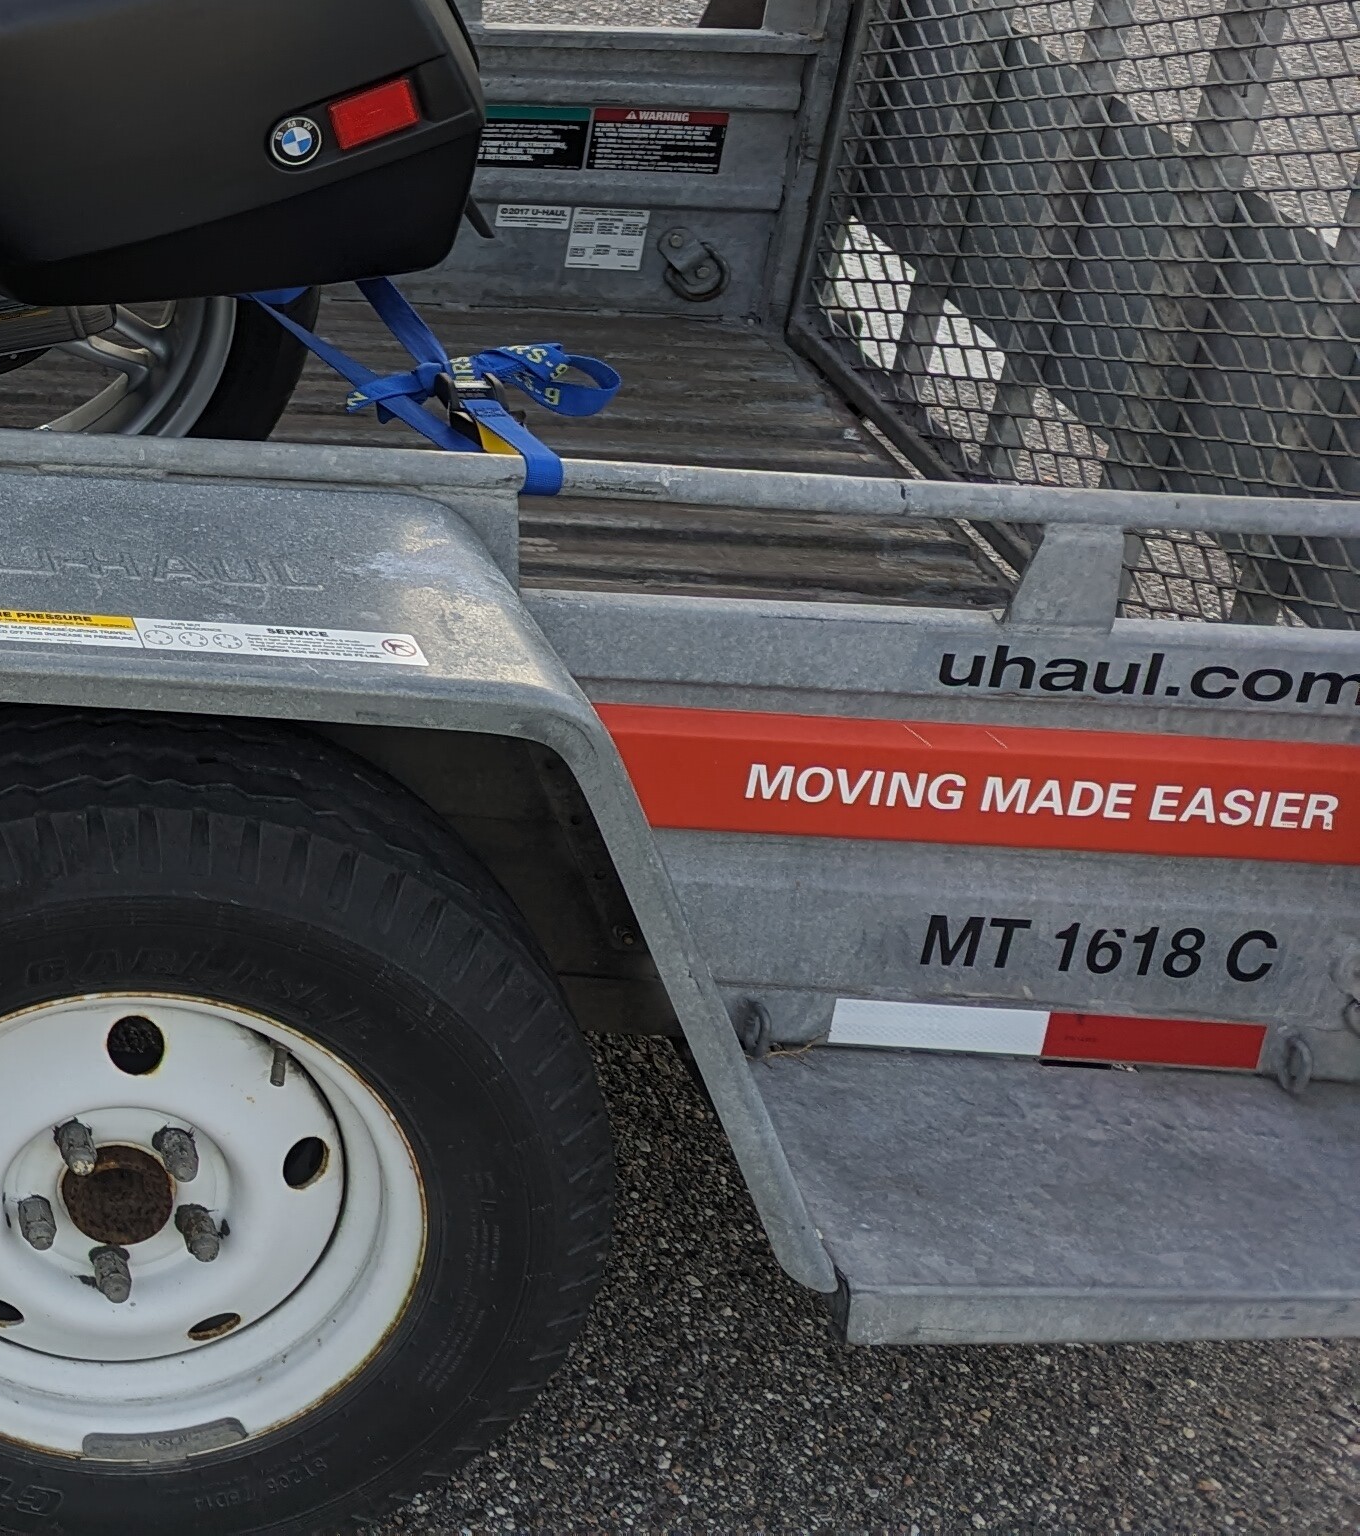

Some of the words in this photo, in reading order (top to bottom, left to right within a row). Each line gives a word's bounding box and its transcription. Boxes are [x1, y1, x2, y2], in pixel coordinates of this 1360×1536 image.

[639, 111, 690, 122] WARNING
[276, 121, 314, 141] BMW
[16, 612, 93, 622] PRESSURE
[267, 627, 329, 638] SERVICE
[939, 645, 1360, 705] uhaul.com
[745, 764, 965, 809] MOVING
[981, 778, 1136, 819] MADE
[1148, 786, 1339, 830] EASIER
[921, 915, 1032, 968] MT
[1055, 923, 1206, 979] 1618
[1226, 930, 1278, 982] C
